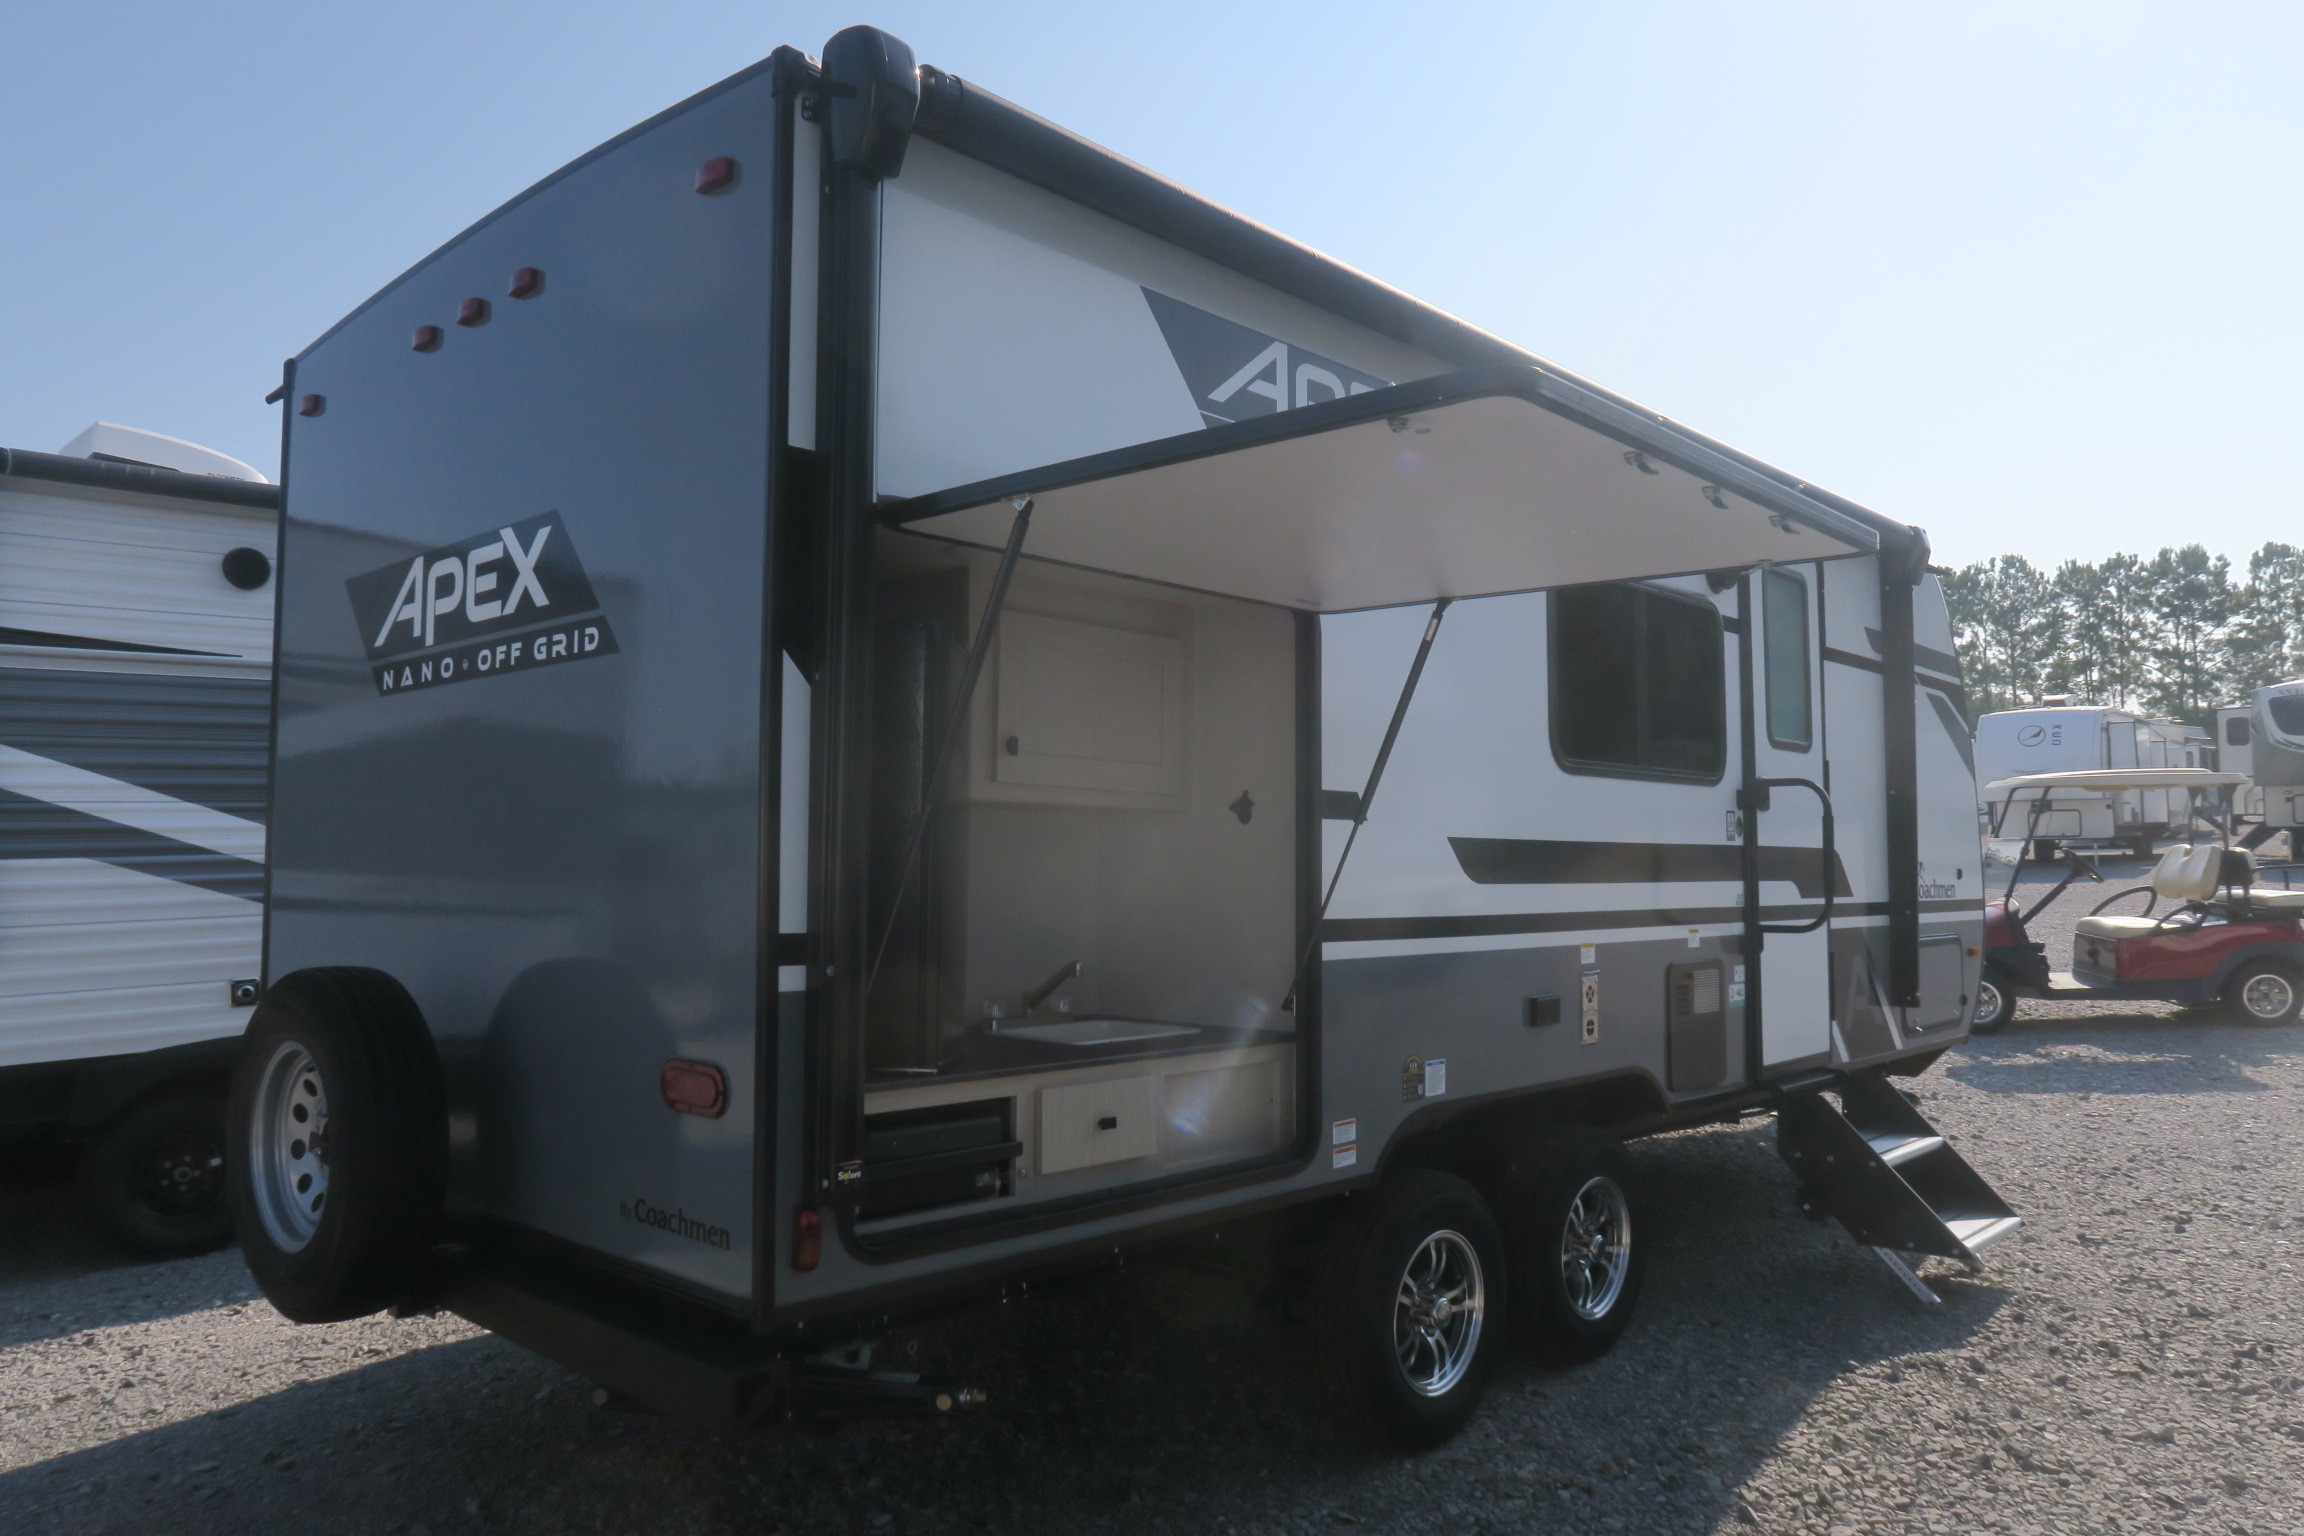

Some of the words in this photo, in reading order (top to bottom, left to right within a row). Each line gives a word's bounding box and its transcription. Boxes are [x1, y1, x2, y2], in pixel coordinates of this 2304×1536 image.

[1207, 340, 1376, 413] AP
[374, 525, 552, 647] APEX
[383, 657, 454, 690] NANO
[477, 642, 522, 671] OFF
[534, 626, 600, 661] GRID
[1918, 879, 1956, 899] oachmen
[635, 1198, 730, 1251] Coachmen
